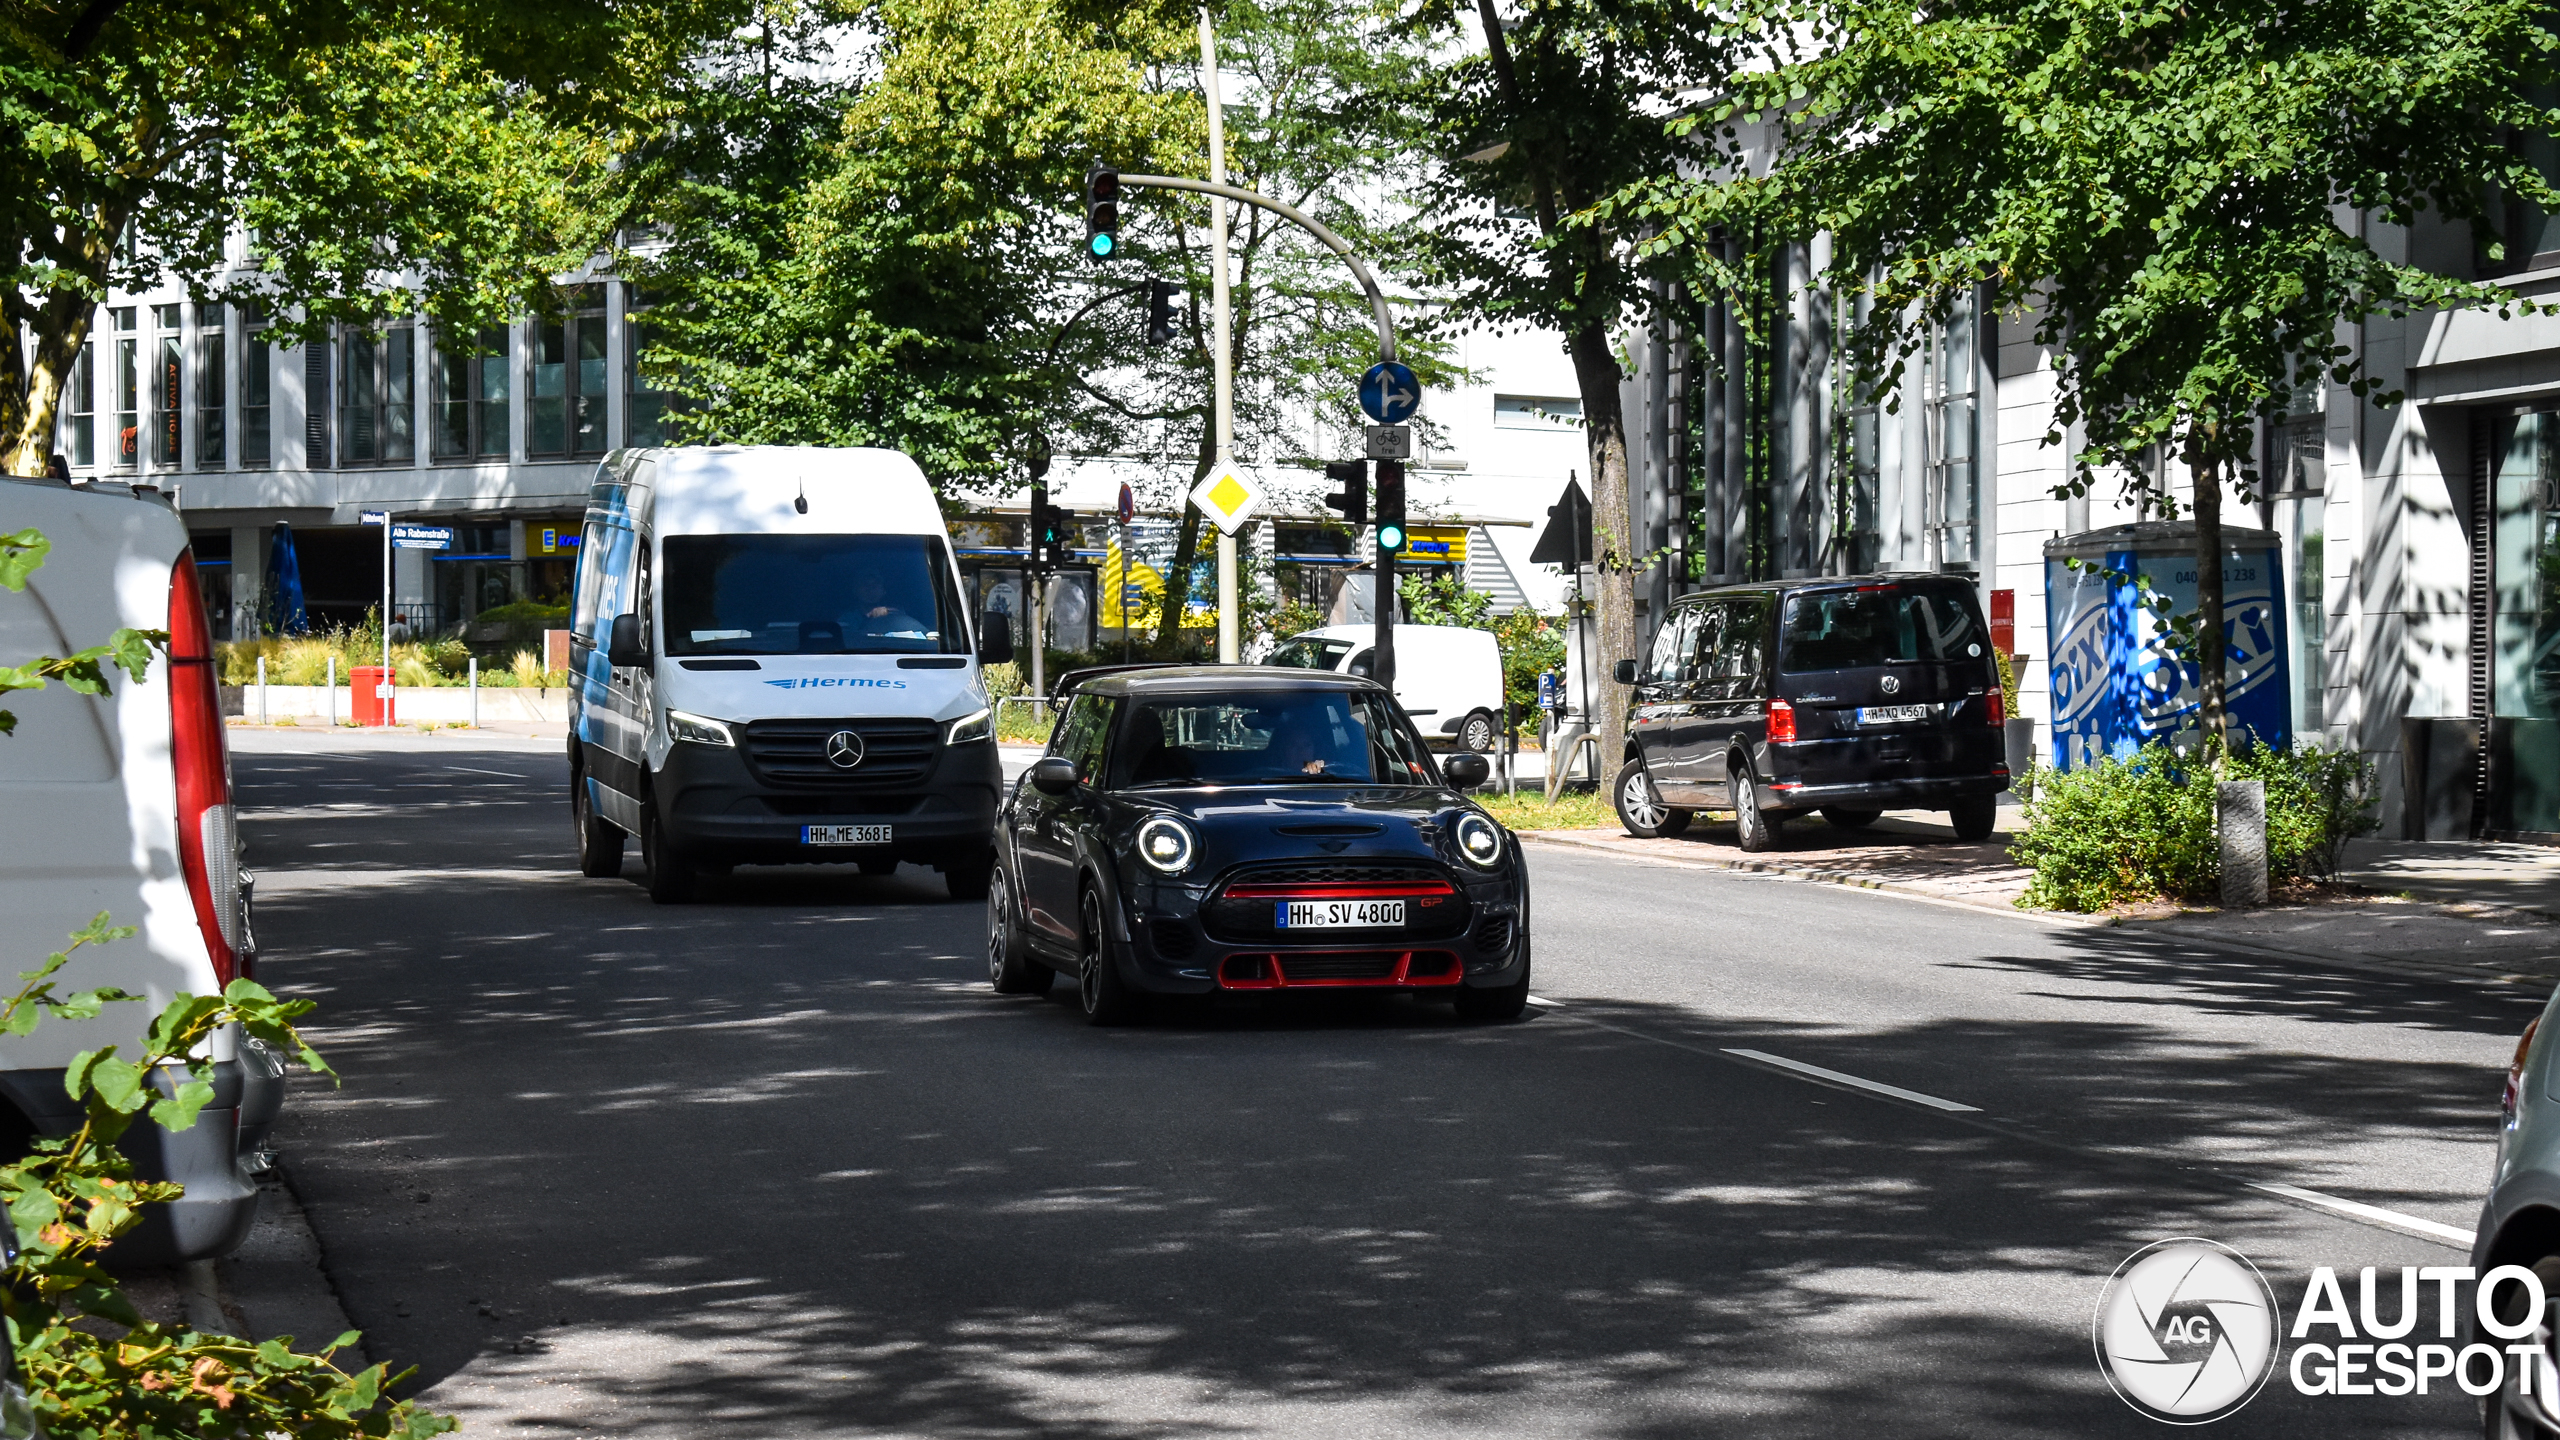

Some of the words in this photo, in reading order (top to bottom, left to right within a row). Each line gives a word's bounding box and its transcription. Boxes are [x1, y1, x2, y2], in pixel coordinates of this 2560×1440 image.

[392, 527, 407, 537] Alte
[407, 528, 450, 539] Rabenstraße
[2176, 571, 2198, 584] 040
[2233, 568, 2256, 581] 238
[800, 677, 907, 689] Hermes
[1865, 709, 1878, 721] HH
[1885, 707, 1898, 719] XQ
[1901, 705, 1925, 718] 4567
[810, 827, 828, 842] HH
[836, 827, 854, 842] ME
[1420, 897, 1443, 907] GP
[1289, 904, 1314, 925] HH
[1328, 903, 1352, 924] SV
[1357, 902, 1403, 924] 4800
